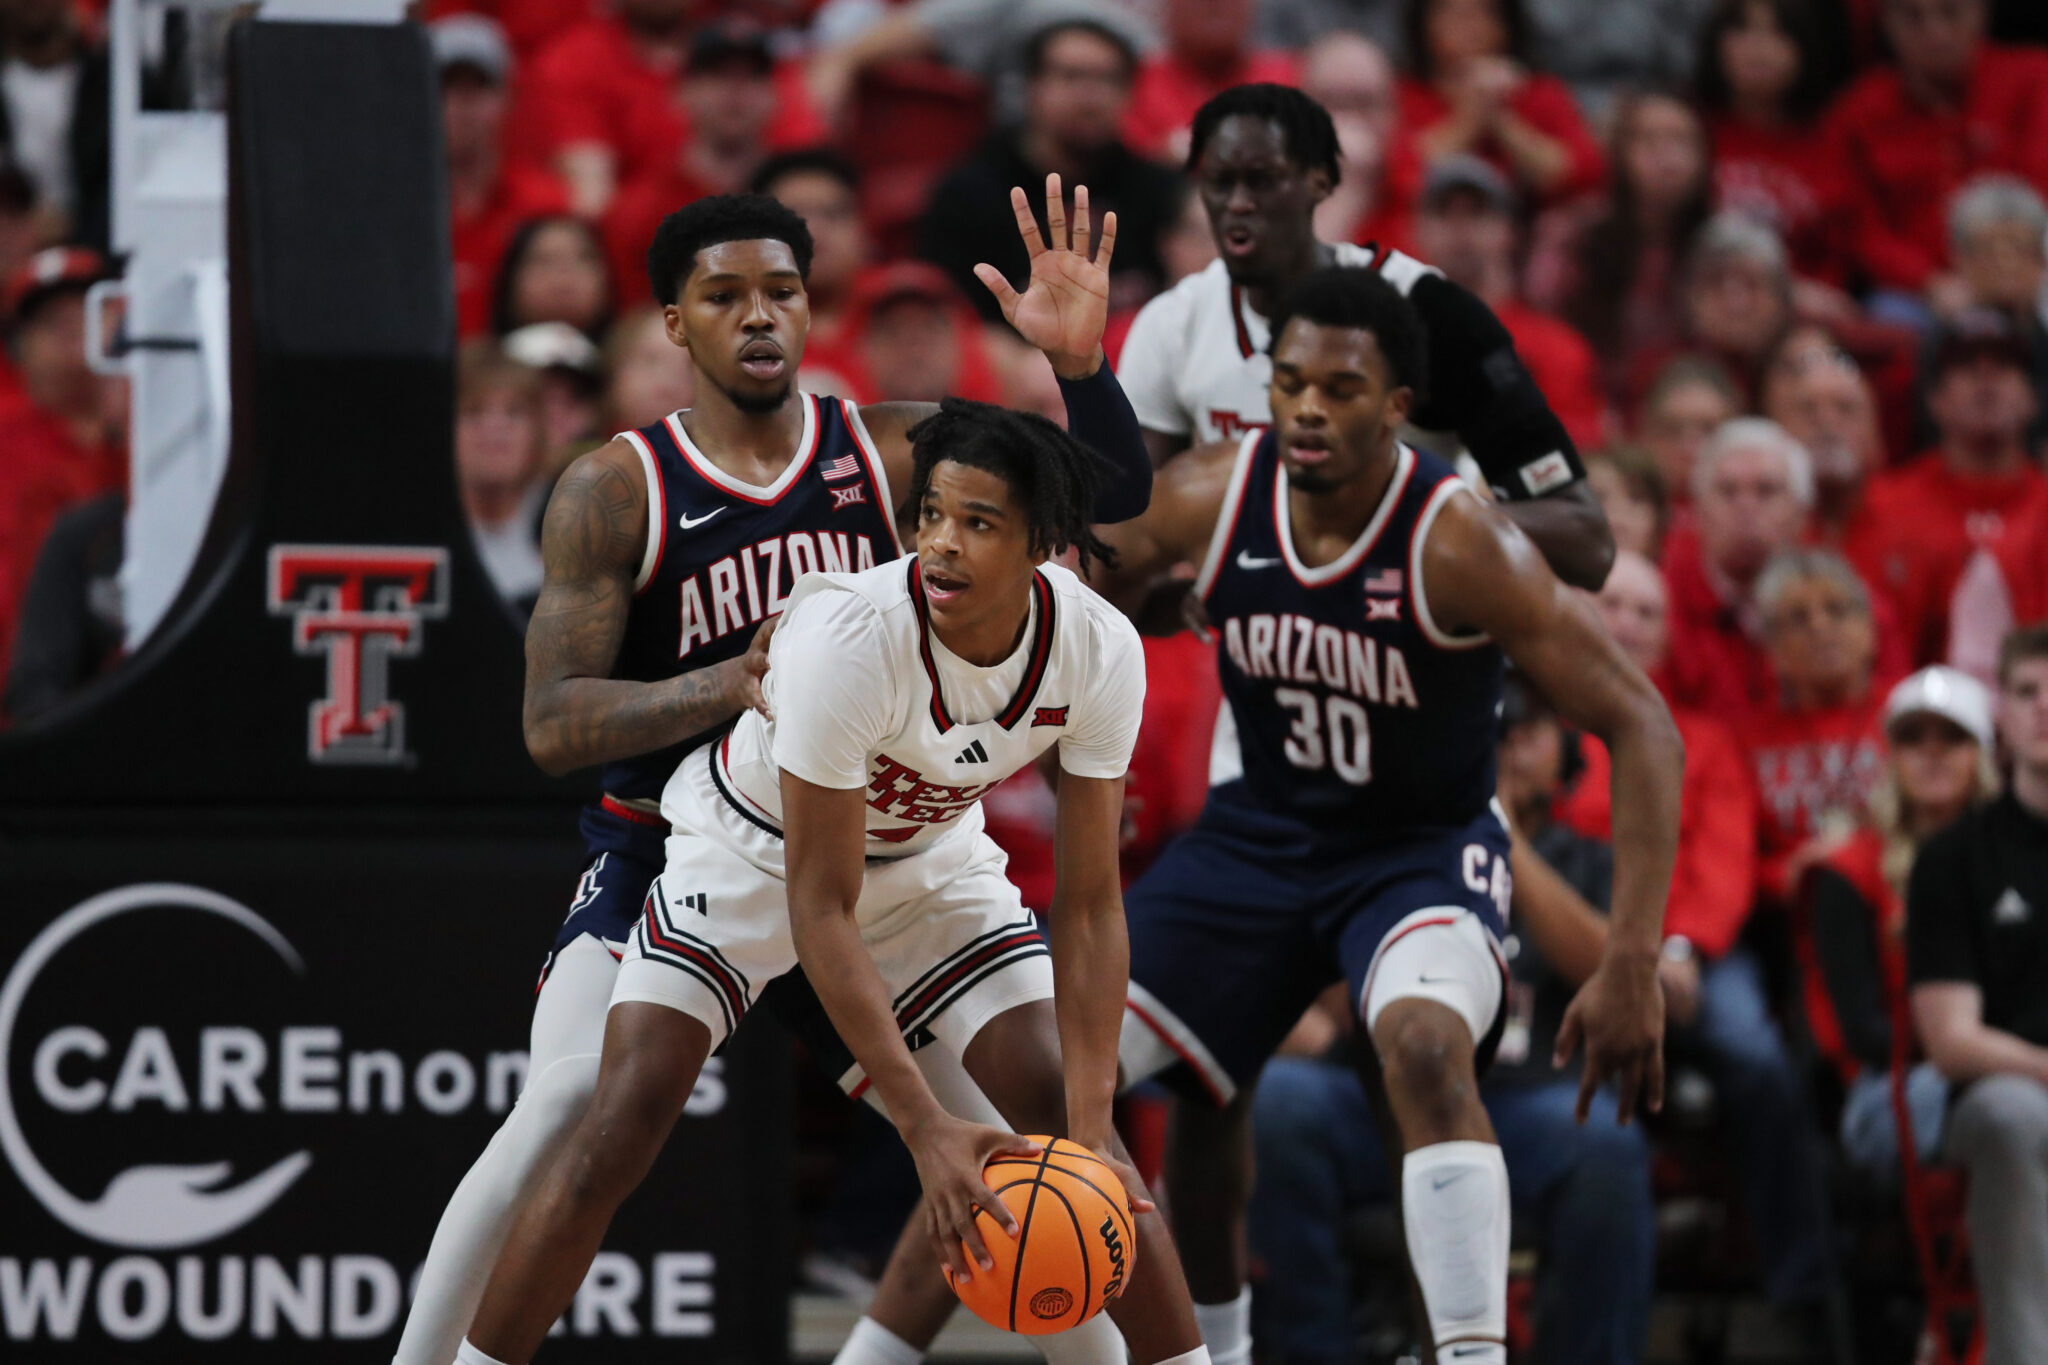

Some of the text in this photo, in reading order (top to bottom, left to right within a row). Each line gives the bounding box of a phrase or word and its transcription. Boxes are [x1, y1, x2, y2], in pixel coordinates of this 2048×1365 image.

[828, 480, 867, 511] XII
[1225, 614, 1418, 708] ARIZONA
[1031, 704, 1070, 728] XII
[1275, 687, 1372, 785] 30
[33, 1025, 728, 1115] CAREnos
[0, 1252, 717, 1342] WOUNDRE
